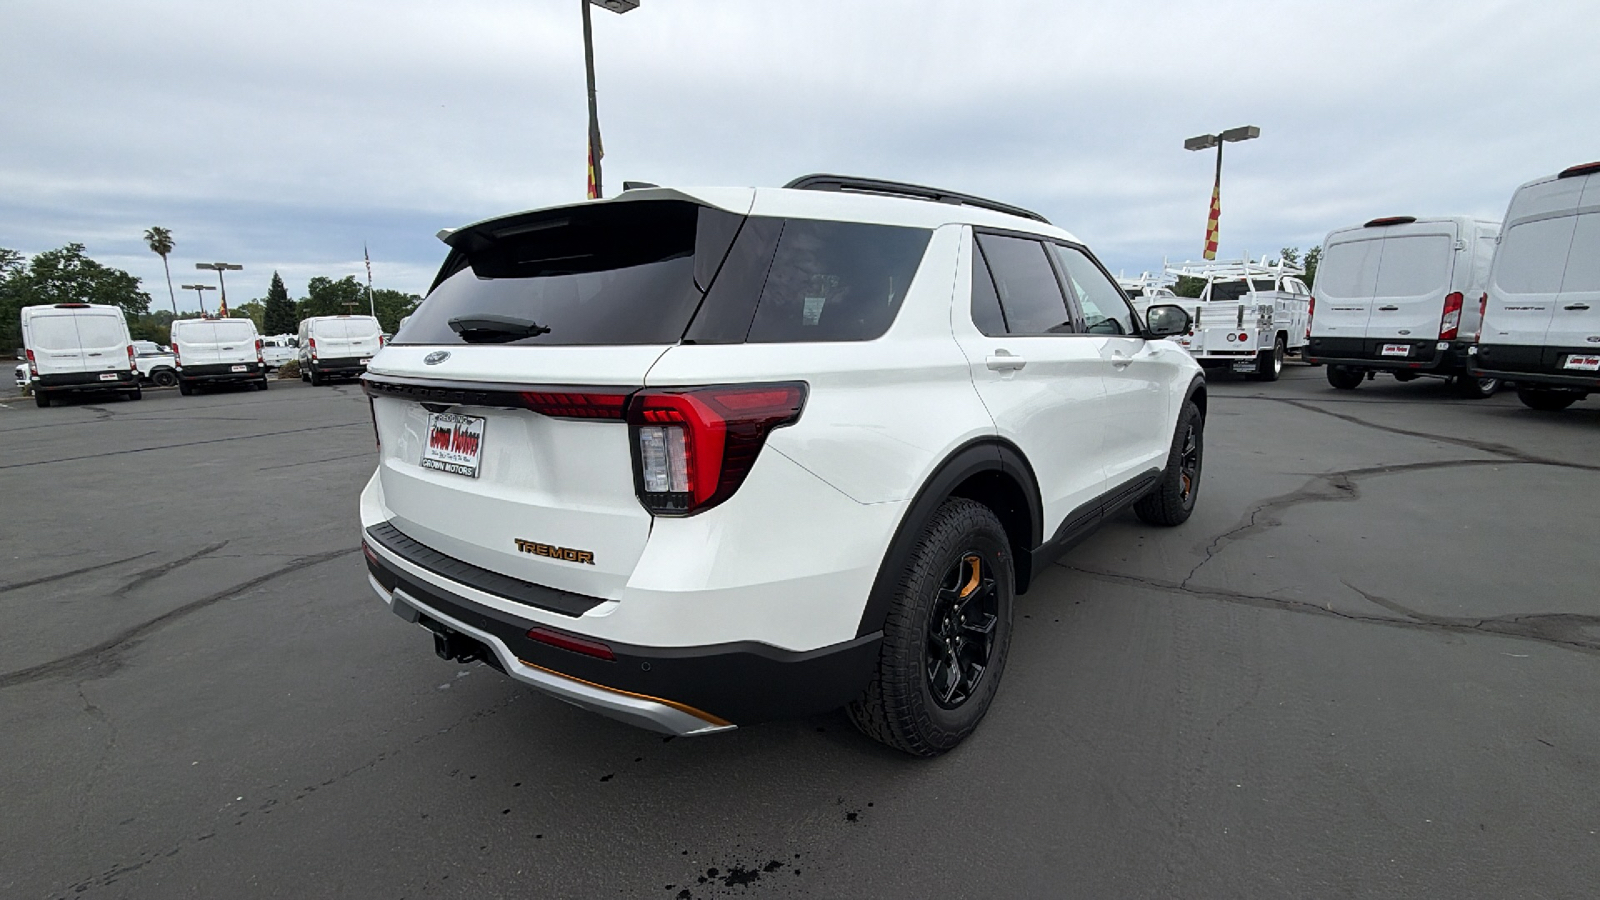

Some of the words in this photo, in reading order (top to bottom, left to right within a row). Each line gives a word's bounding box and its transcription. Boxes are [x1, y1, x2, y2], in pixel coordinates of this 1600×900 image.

[438, 414, 468, 424] REDDING
[422, 458, 445, 471] CROWN
[445, 462, 472, 476] MOTORS
[514, 537, 596, 565] TREMOR
